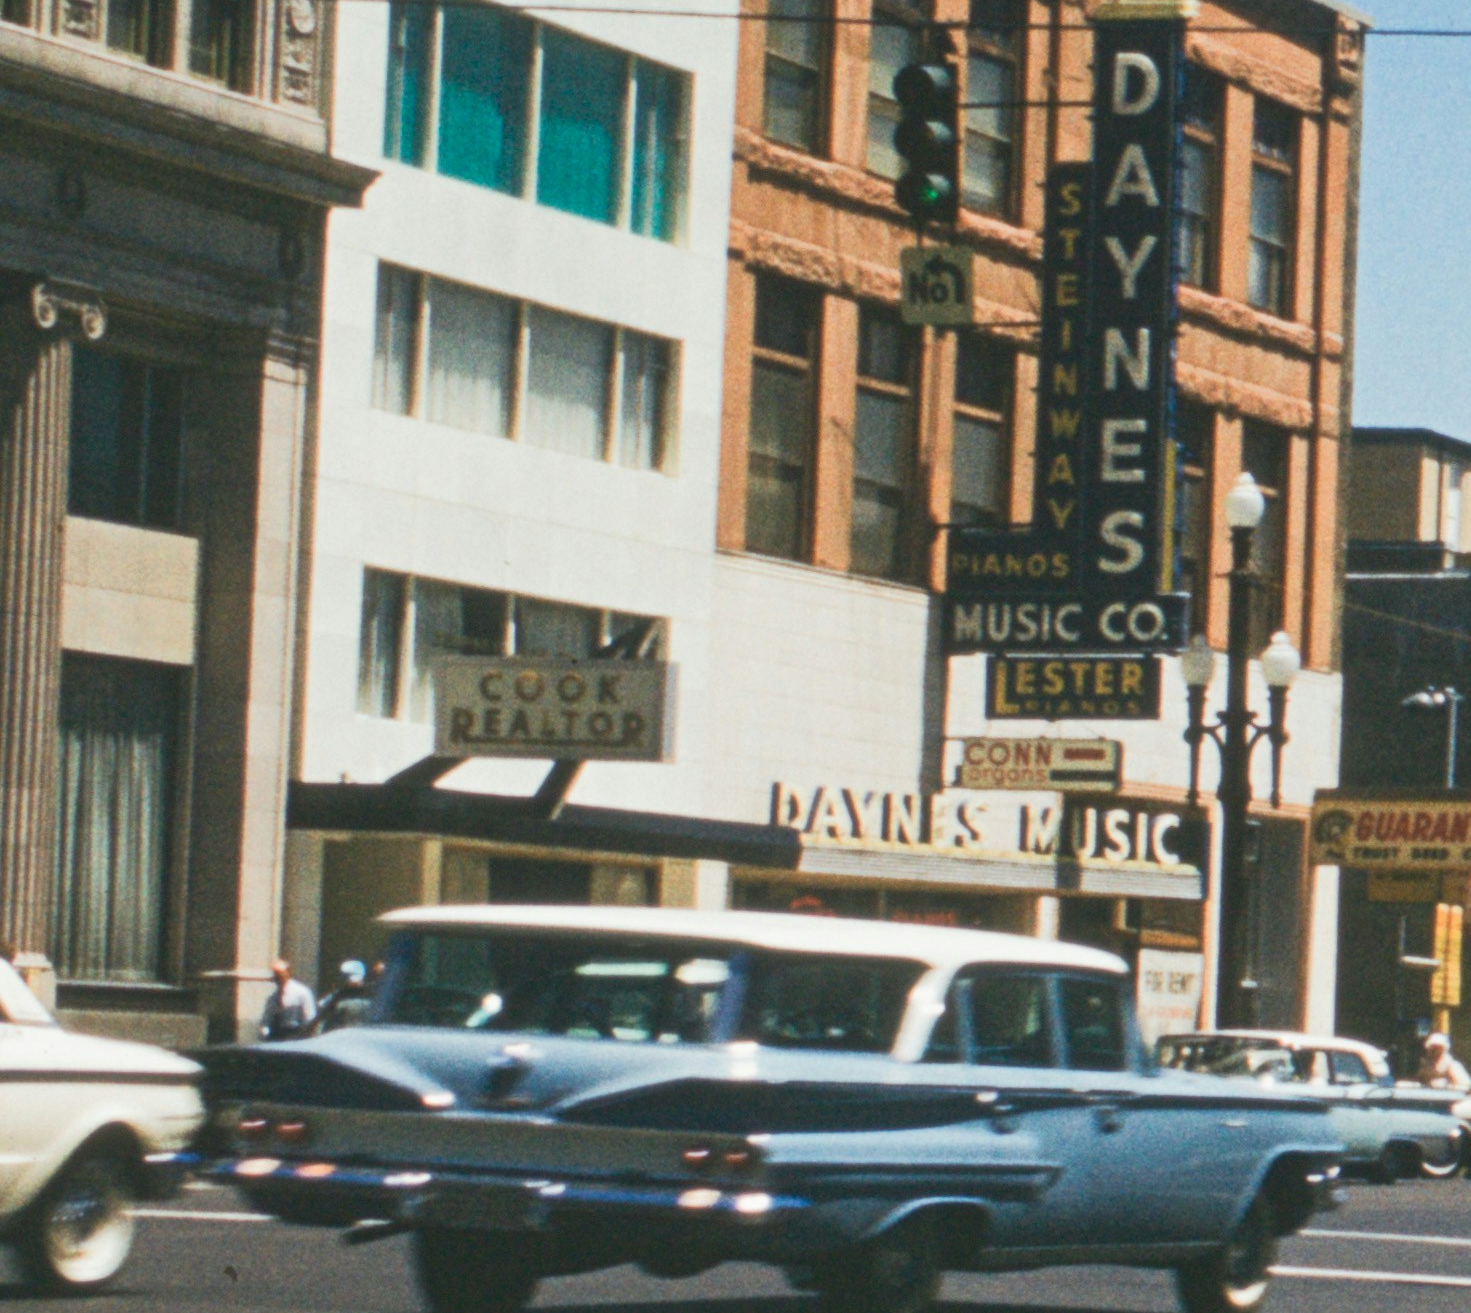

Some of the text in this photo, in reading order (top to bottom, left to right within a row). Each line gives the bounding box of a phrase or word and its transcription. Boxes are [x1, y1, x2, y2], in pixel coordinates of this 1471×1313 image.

[1099, 51, 1163, 574] DAYNES
[1048, 181, 1081, 530] STEINWAY
[952, 553, 1071, 578] PIANOS
[953, 601, 1169, 642] MUSIC CO.
[480, 669, 623, 704] COOK
[994, 660, 1144, 715] LESTER
[451, 706, 646, 747] REALTOR
[1026, 700, 1142, 716] PIANOS
[964, 742, 1052, 767] CONN
[1020, 802, 1181, 865] MUSIC
[1353, 846, 1400, 861] TRUST
